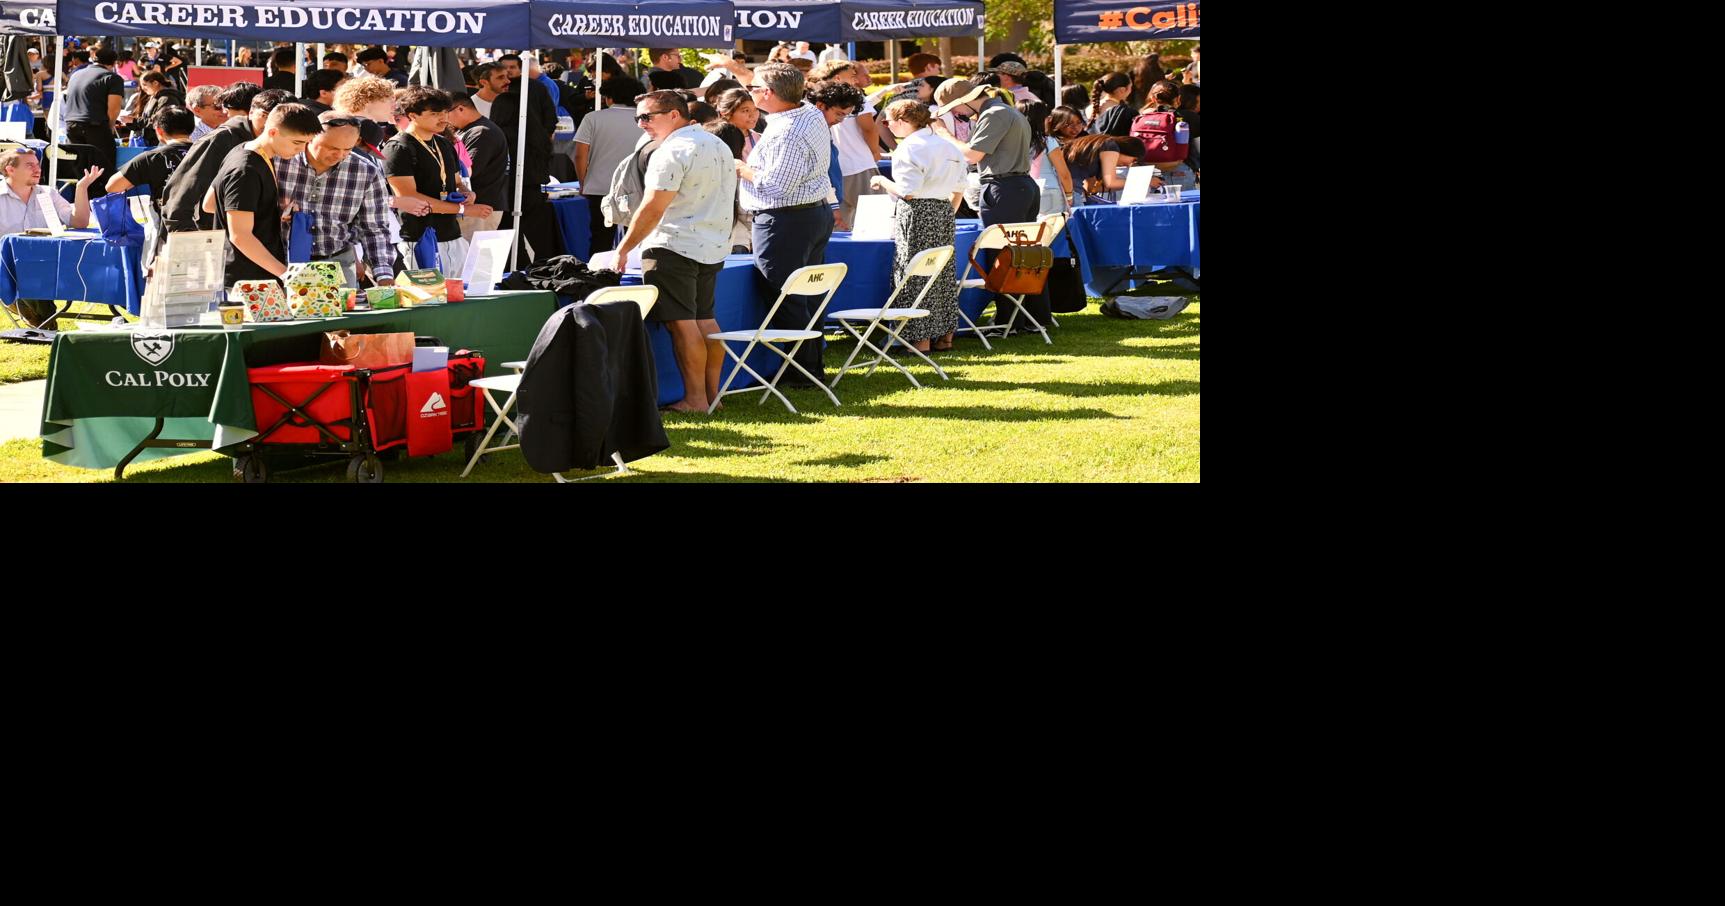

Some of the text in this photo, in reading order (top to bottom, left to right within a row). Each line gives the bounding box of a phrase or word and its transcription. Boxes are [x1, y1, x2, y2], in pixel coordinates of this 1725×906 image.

[95, 2, 486, 33] CAREER EDUCATION
[548, 13, 720, 36] CAREER EDUCATION
[735, 10, 803, 28] ION
[852, 8, 975, 30] CAREER EDUCATION
[1098, 3, 1200, 30] #Cali
[808, 273, 824, 283] AHC
[105, 370, 212, 387] CAL POLY
